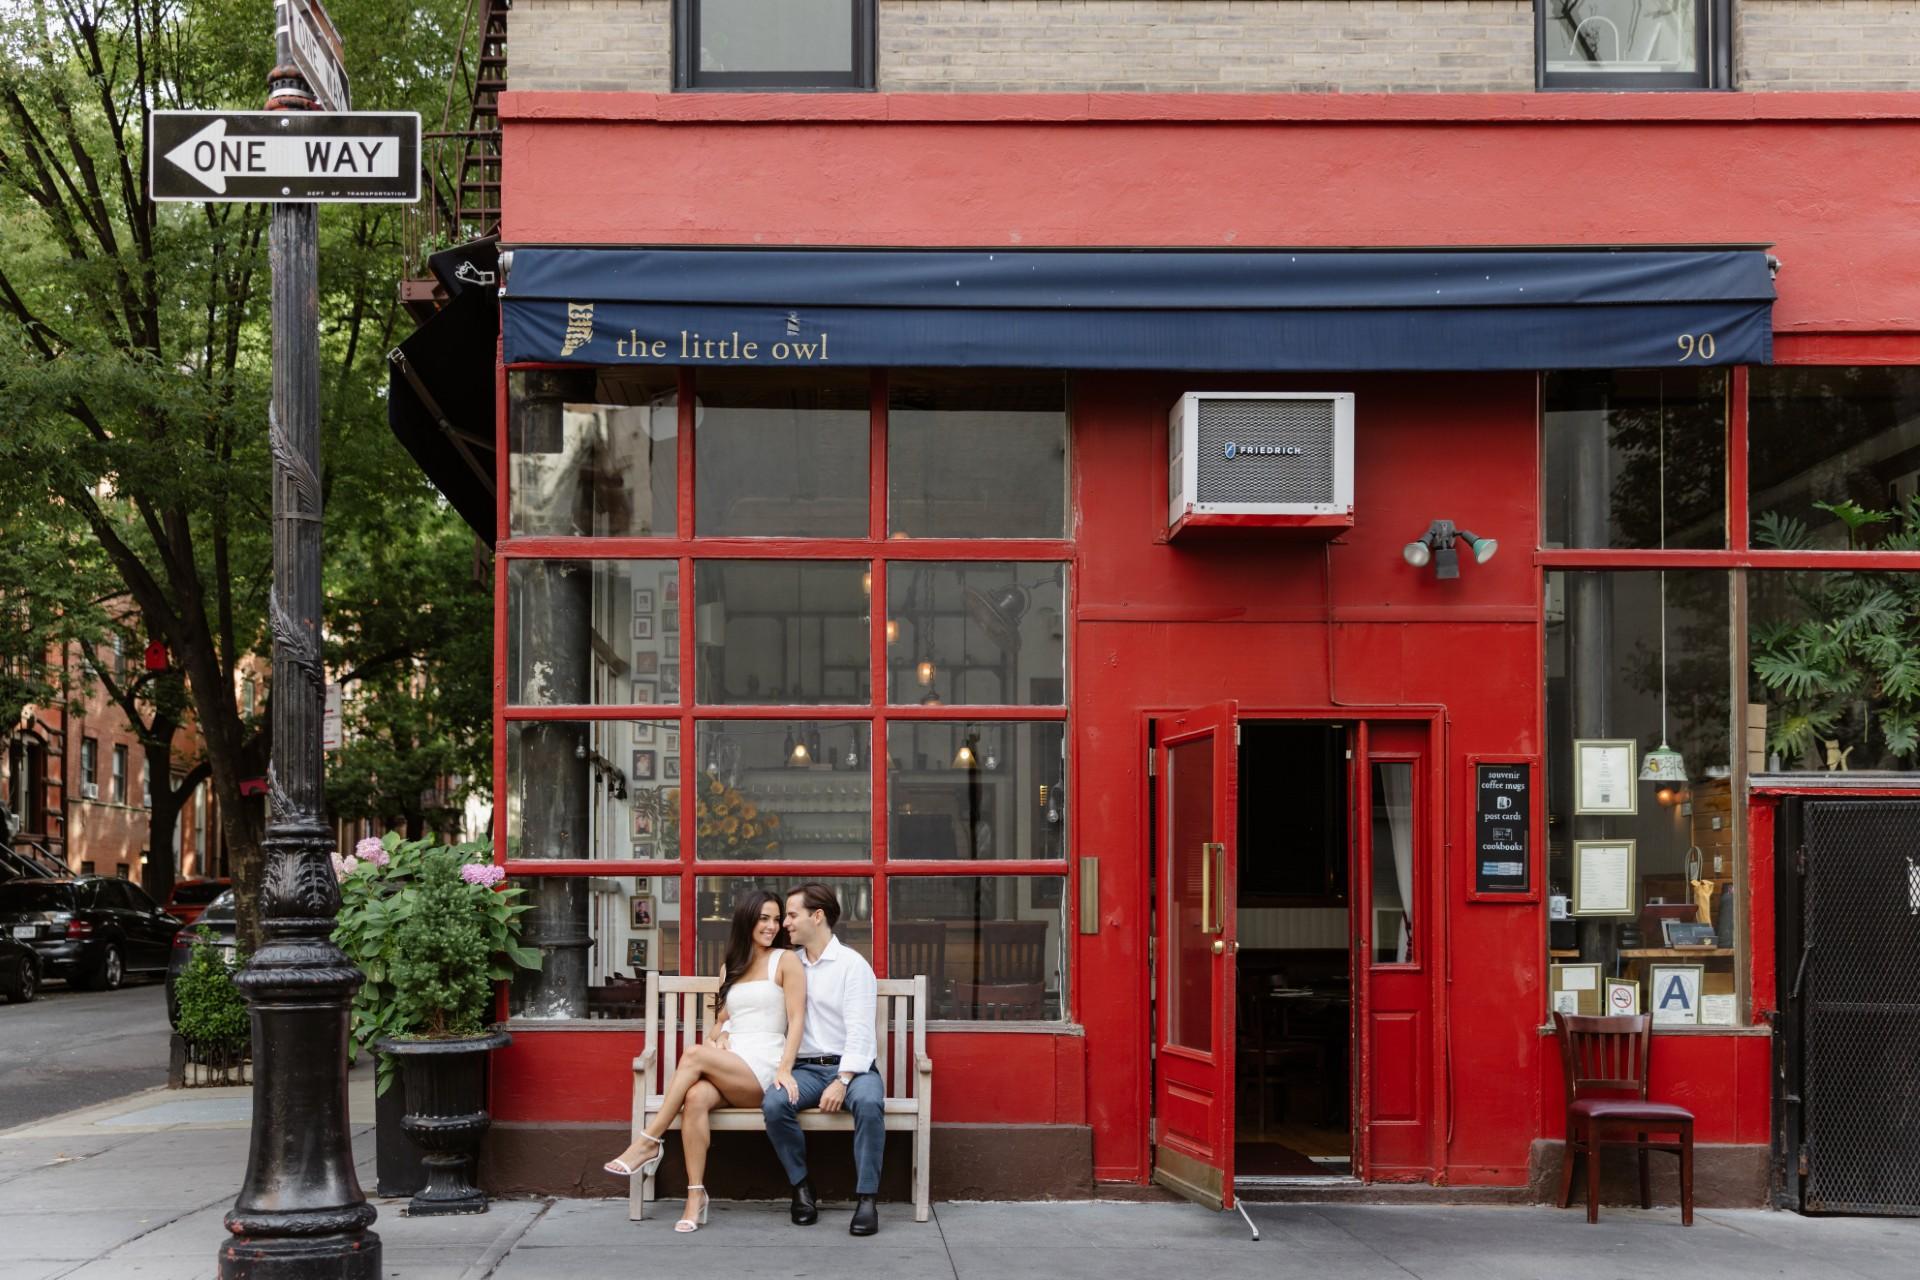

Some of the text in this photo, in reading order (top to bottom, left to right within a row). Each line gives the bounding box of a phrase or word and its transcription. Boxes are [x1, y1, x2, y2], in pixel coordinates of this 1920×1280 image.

[298, 17, 319, 73] ONE
[194, 141, 383, 172] ONE WAY
[616, 329, 829, 360] the little owl
[1678, 333, 1716, 361] 90
[1240, 446, 1301, 454] FRIEDRICH
[1488, 771, 1520, 779] souvenir
[1481, 780, 1525, 792] coffee mugs
[1484, 811, 1522, 822] post cards
[1482, 842, 1523, 851] cookbooks
[1659, 975, 1690, 1009] A
